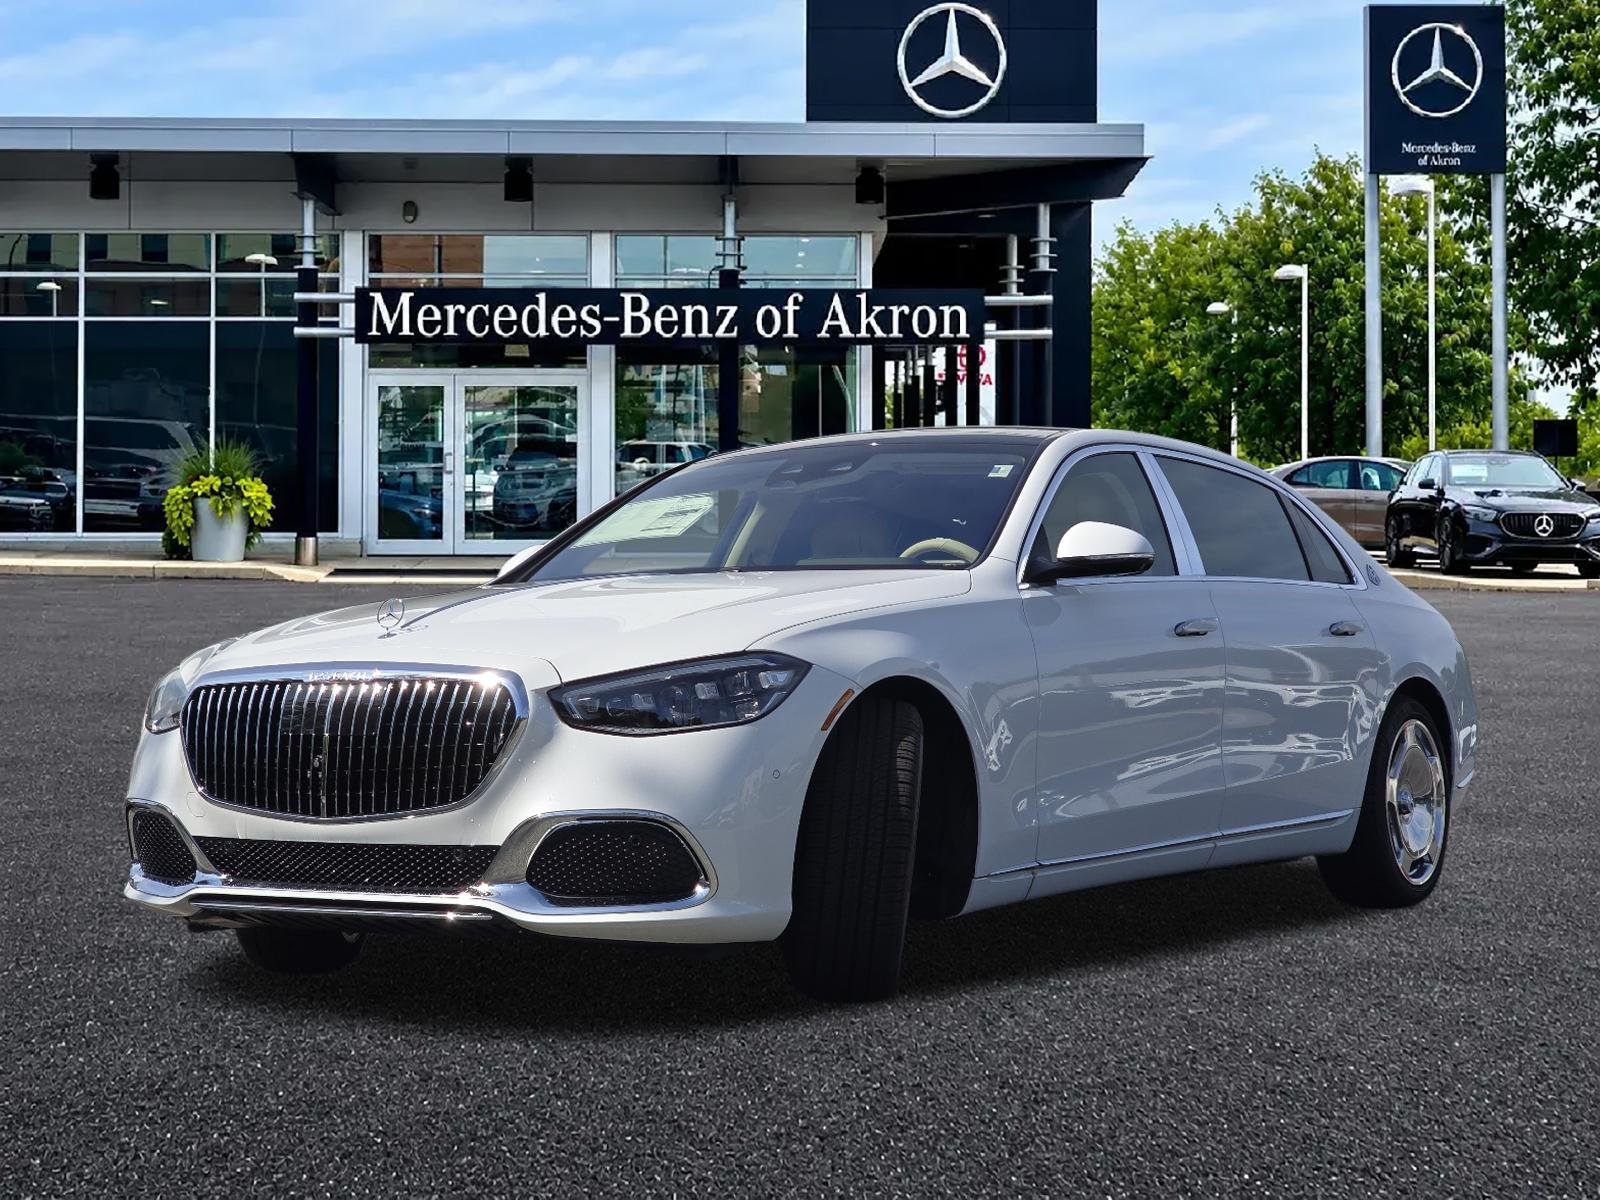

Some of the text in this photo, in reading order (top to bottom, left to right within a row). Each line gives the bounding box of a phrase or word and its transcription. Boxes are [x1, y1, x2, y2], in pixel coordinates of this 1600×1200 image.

[1401, 141, 1477, 154] Mercedes-Benz
[1417, 154, 1461, 166] of Akron
[367, 291, 971, 339] Mercedes-Benz of Akron
